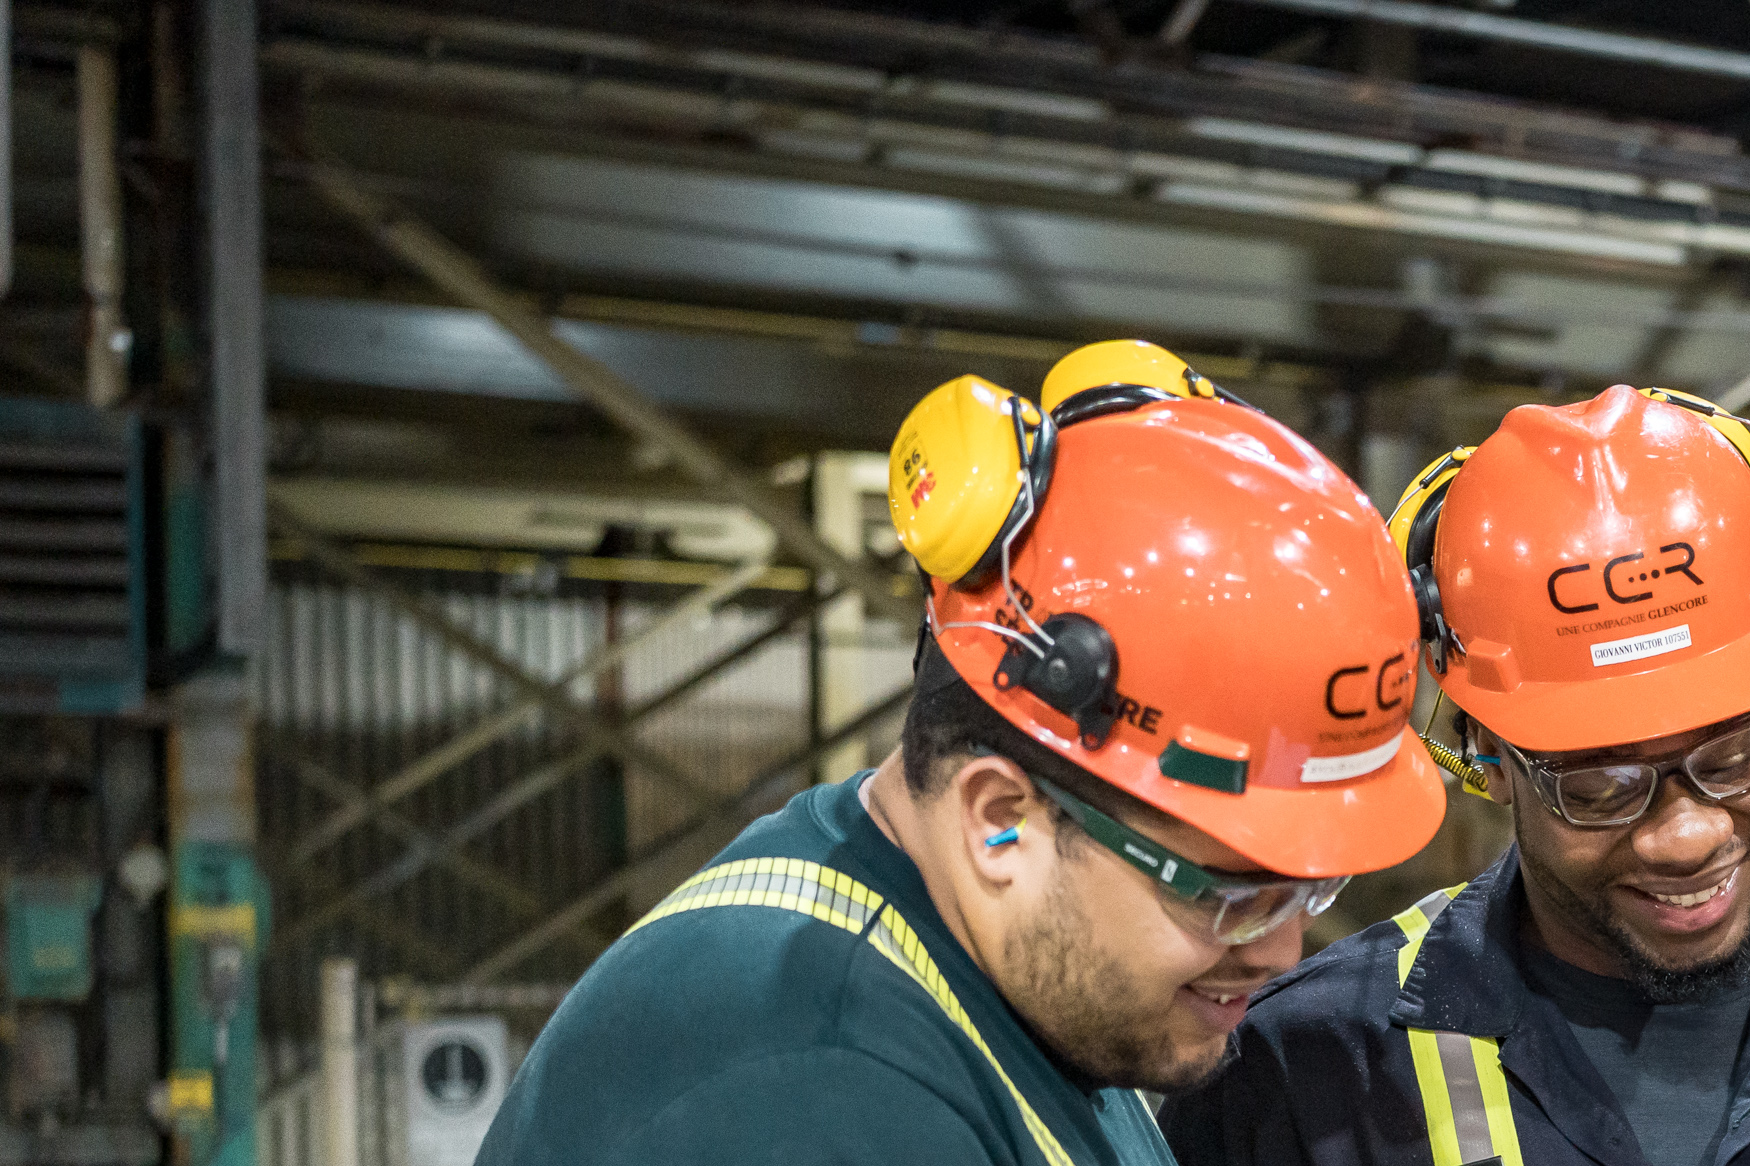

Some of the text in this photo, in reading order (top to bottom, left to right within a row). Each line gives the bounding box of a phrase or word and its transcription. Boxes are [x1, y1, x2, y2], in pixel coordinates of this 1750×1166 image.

[911, 471, 937, 510] 3M
[1556, 595, 1709, 637] UNE COMPAGNIE GLENCORE
[1594, 630, 1690, 660] GIOVANNI VICTOR 107551
